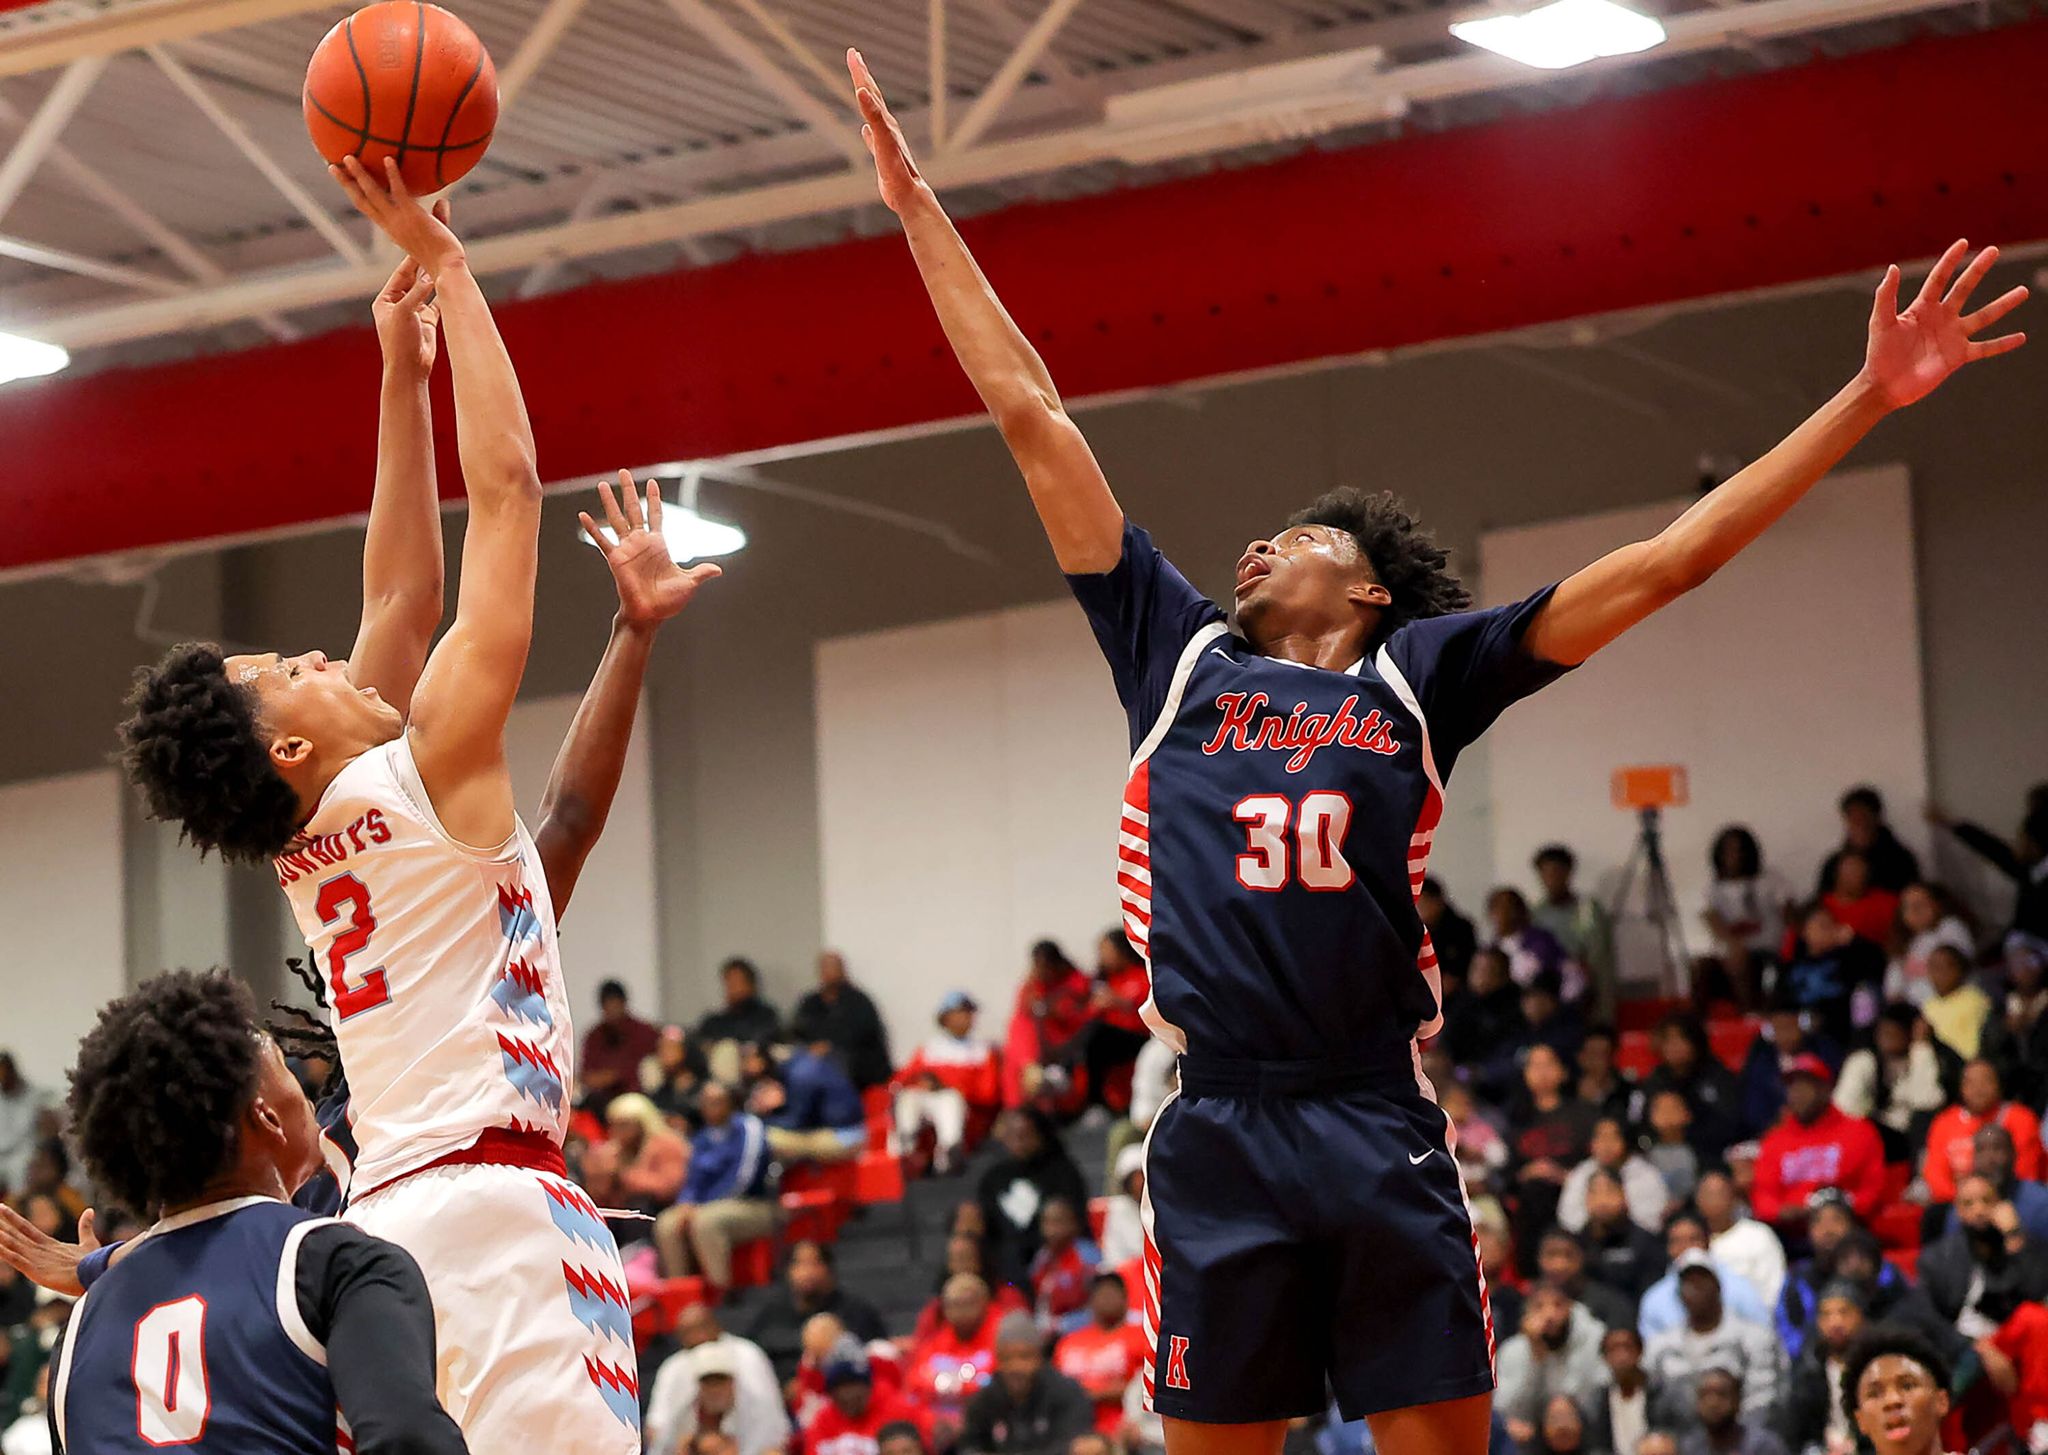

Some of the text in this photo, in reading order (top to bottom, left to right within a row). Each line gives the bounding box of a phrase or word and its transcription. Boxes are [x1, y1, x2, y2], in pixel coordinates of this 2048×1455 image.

[1202, 692, 1400, 773] Knights
[273, 807, 392, 888] OWBOYS
[1232, 789, 1356, 892] 30
[313, 869, 393, 1024] 2
[131, 1292, 212, 1448] 0
[1166, 1334, 1191, 1390] K
